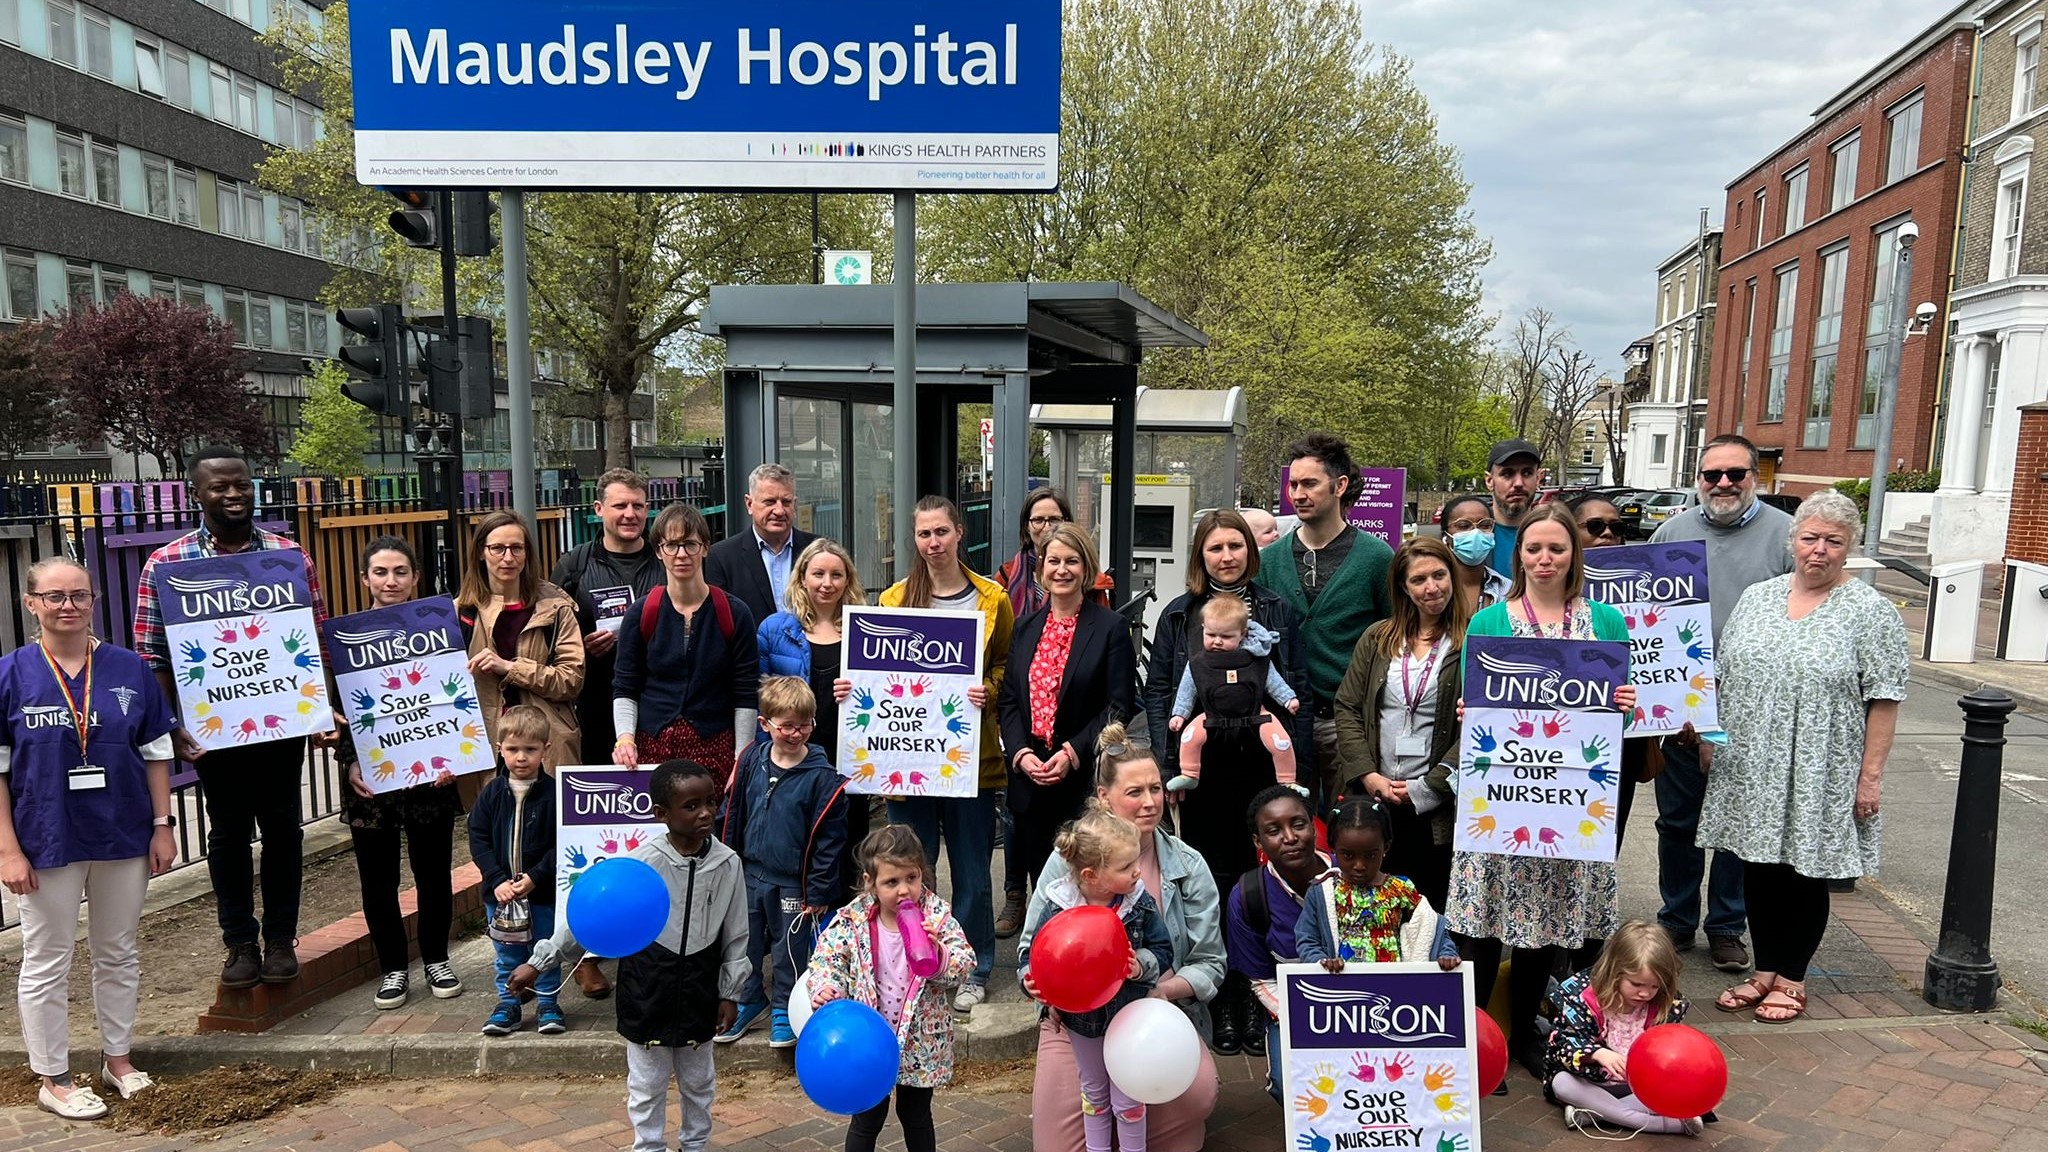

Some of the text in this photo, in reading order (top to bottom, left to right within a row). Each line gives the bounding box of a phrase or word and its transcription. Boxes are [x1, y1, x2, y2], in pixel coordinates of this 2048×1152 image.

[390, 23, 1018, 101] Maudsley Hospital
[868, 144, 1047, 158] KING'S HEALTH PARTNERS
[369, 166, 558, 177] An Academic Health Sciences Centre for London
[917, 169, 1046, 181] Pioneering better health for all
[1352, 519, 1384, 528] PARKS
[181, 582, 295, 618] UNISON
[1590, 576, 1694, 604] UNISON
[347, 628, 449, 668] UNISON
[862, 637, 964, 664] UNISON
[1630, 636, 1664, 652] ave
[211, 647, 271, 669] Save
[227, 662, 268, 680] OUR
[1631, 666, 1689, 686] RSERY
[206, 675, 299, 704] NURSERY
[1485, 675, 1610, 706] UNISON
[379, 692, 432, 714] Save
[876, 699, 928, 719] Save
[394, 707, 432, 725] OUR
[888, 720, 923, 733] OUR
[377, 717, 461, 749] NURSERY
[867, 736, 948, 753] NURSERY
[1499, 740, 1564, 764] Save
[1513, 766, 1558, 780] OUR
[574, 792, 653, 815] UNISO
[1487, 784, 1588, 806] NURSERY
[1308, 1004, 1446, 1034] UNISON
[1343, 1089, 1407, 1110] Save
[1357, 1107, 1409, 1124] OUR
[1335, 1128, 1424, 1151] NURSERY
